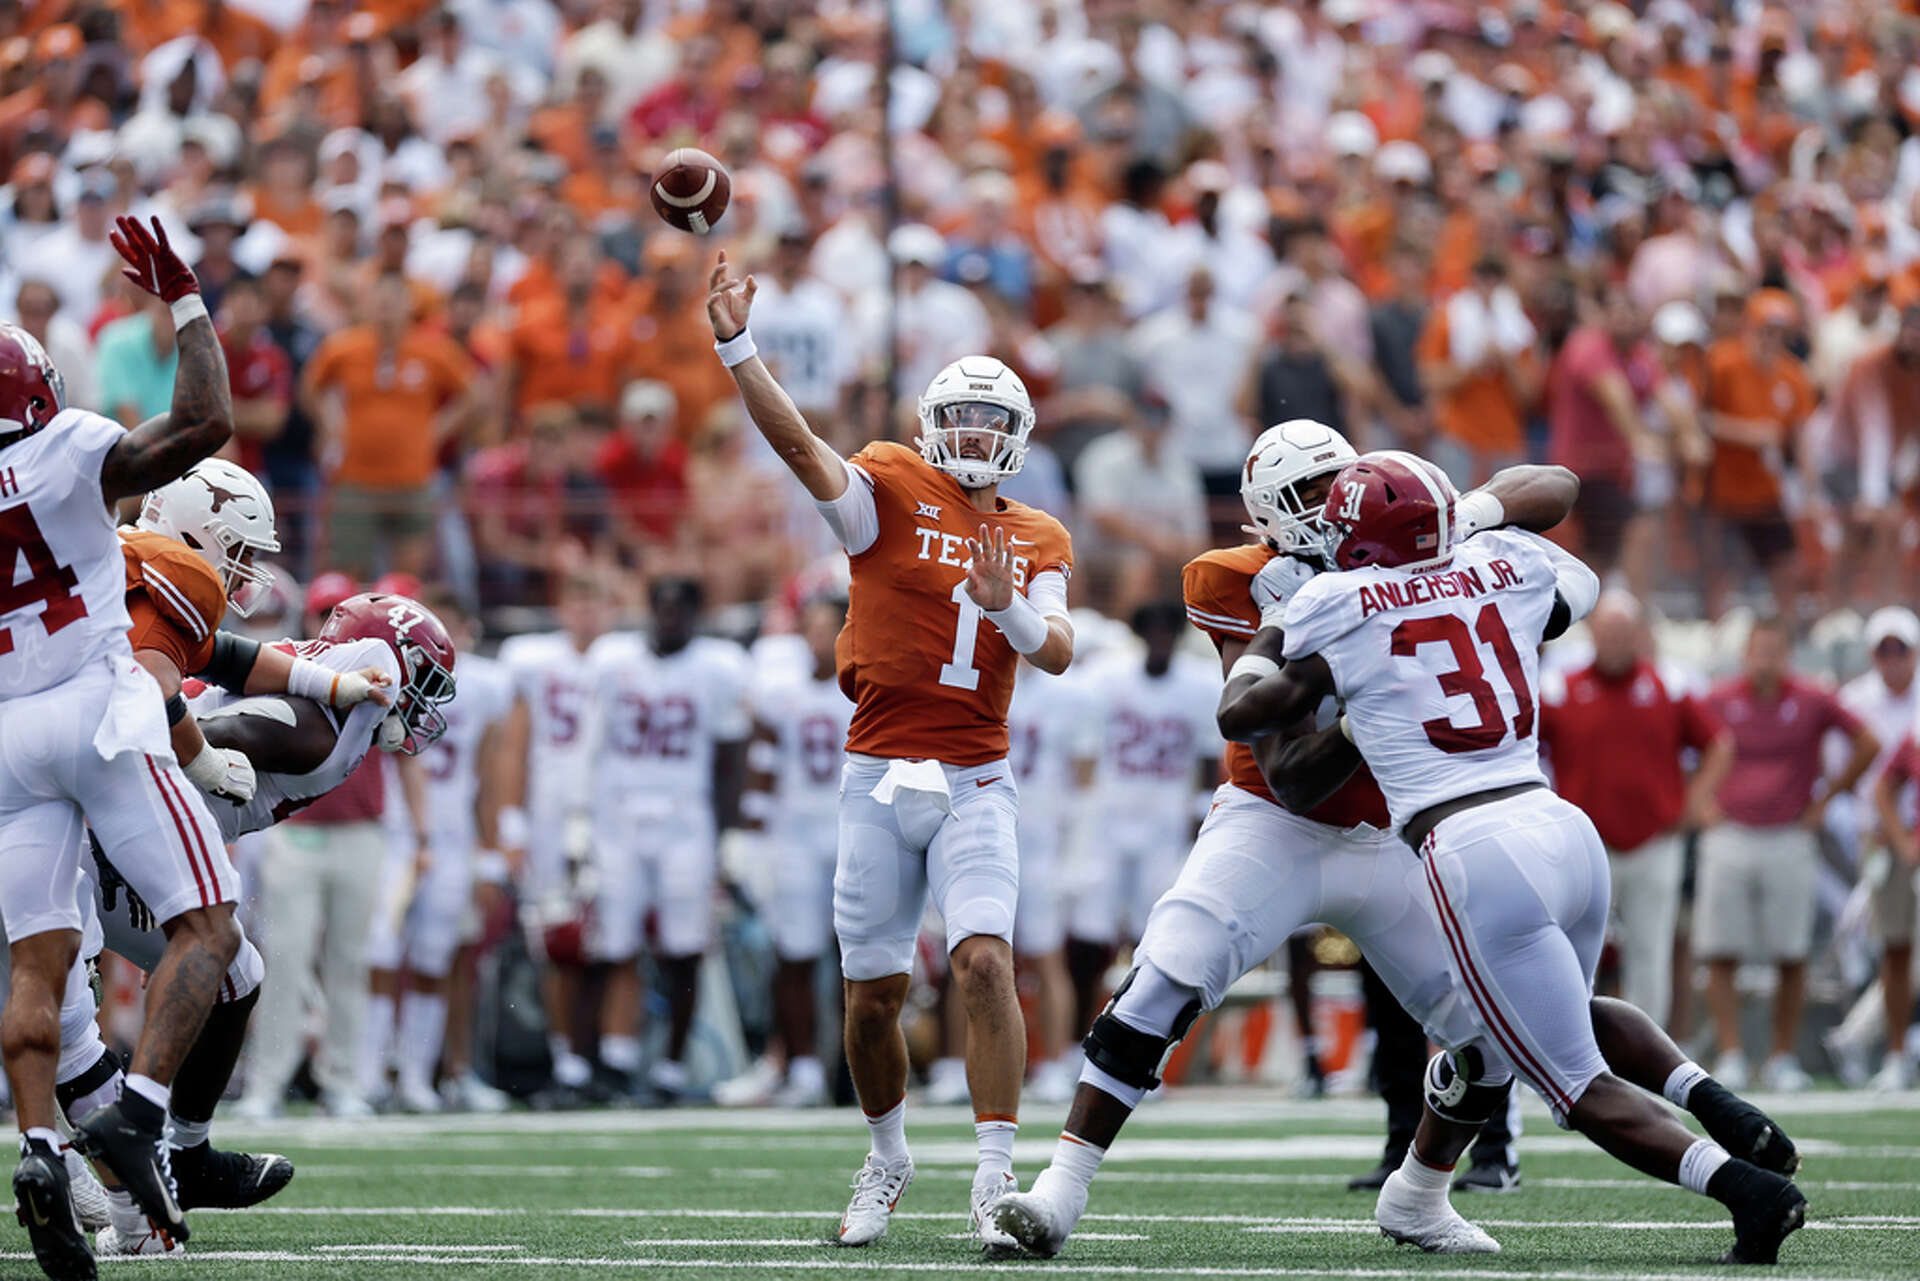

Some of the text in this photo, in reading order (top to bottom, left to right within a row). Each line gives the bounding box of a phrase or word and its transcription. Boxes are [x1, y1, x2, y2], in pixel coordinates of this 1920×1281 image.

[1338, 481, 1366, 521] 31
[0, 502, 89, 655] 4
[915, 527, 1028, 588] TES
[1359, 566, 1487, 618] ANDERSON
[1488, 559, 1523, 591] JR.
[387, 605, 425, 635] 47
[939, 577, 982, 691] 1
[1391, 602, 1535, 754] 31
